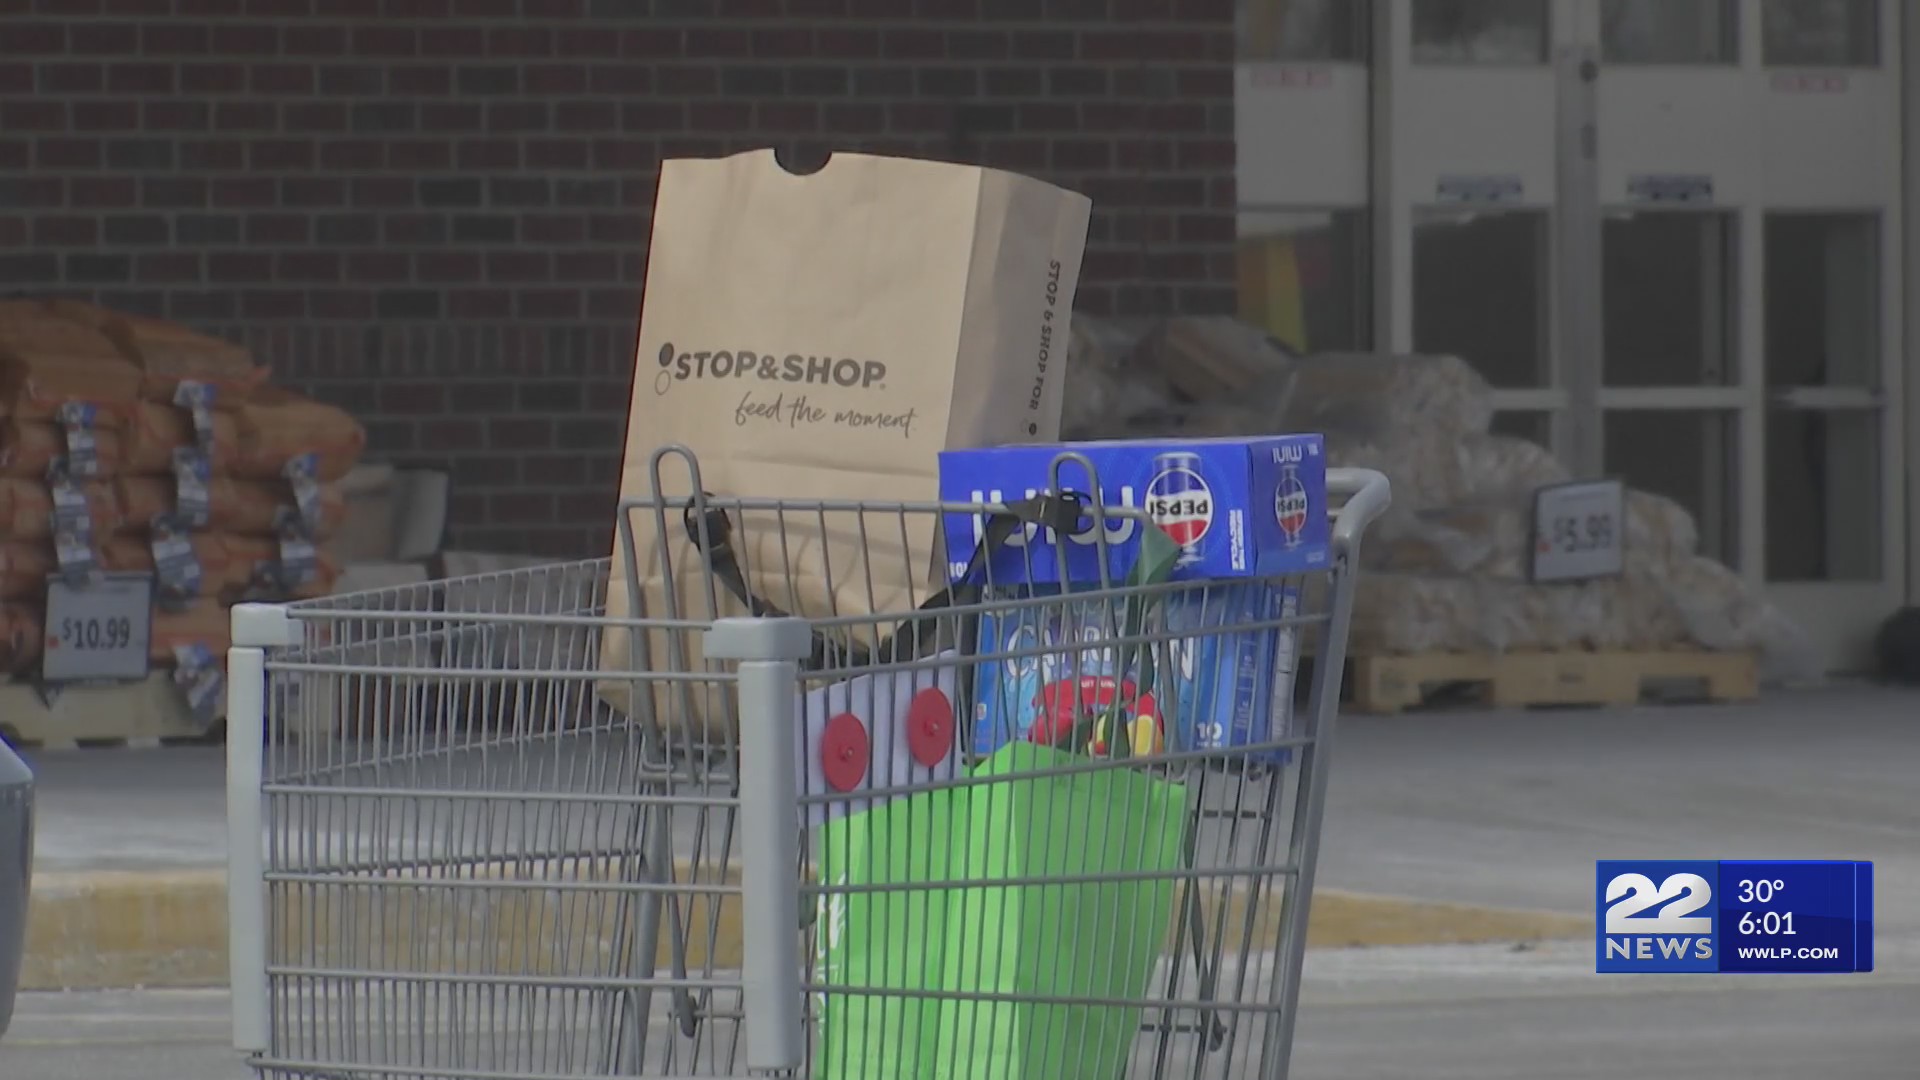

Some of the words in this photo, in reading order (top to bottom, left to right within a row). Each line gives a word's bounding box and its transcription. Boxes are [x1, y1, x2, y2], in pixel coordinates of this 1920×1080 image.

[1046, 260, 1060, 306] STOP
[1038, 325, 1052, 373] SHOP
[736, 391, 781, 427] feed
[790, 396, 826, 428] the
[1029, 377, 1043, 410] FOR
[1151, 500, 1208, 515] PEPSI
[1277, 499, 1305, 512] PEPSI
[1553, 514, 1611, 552] $5.99
[62, 617, 130, 649] $10.99
